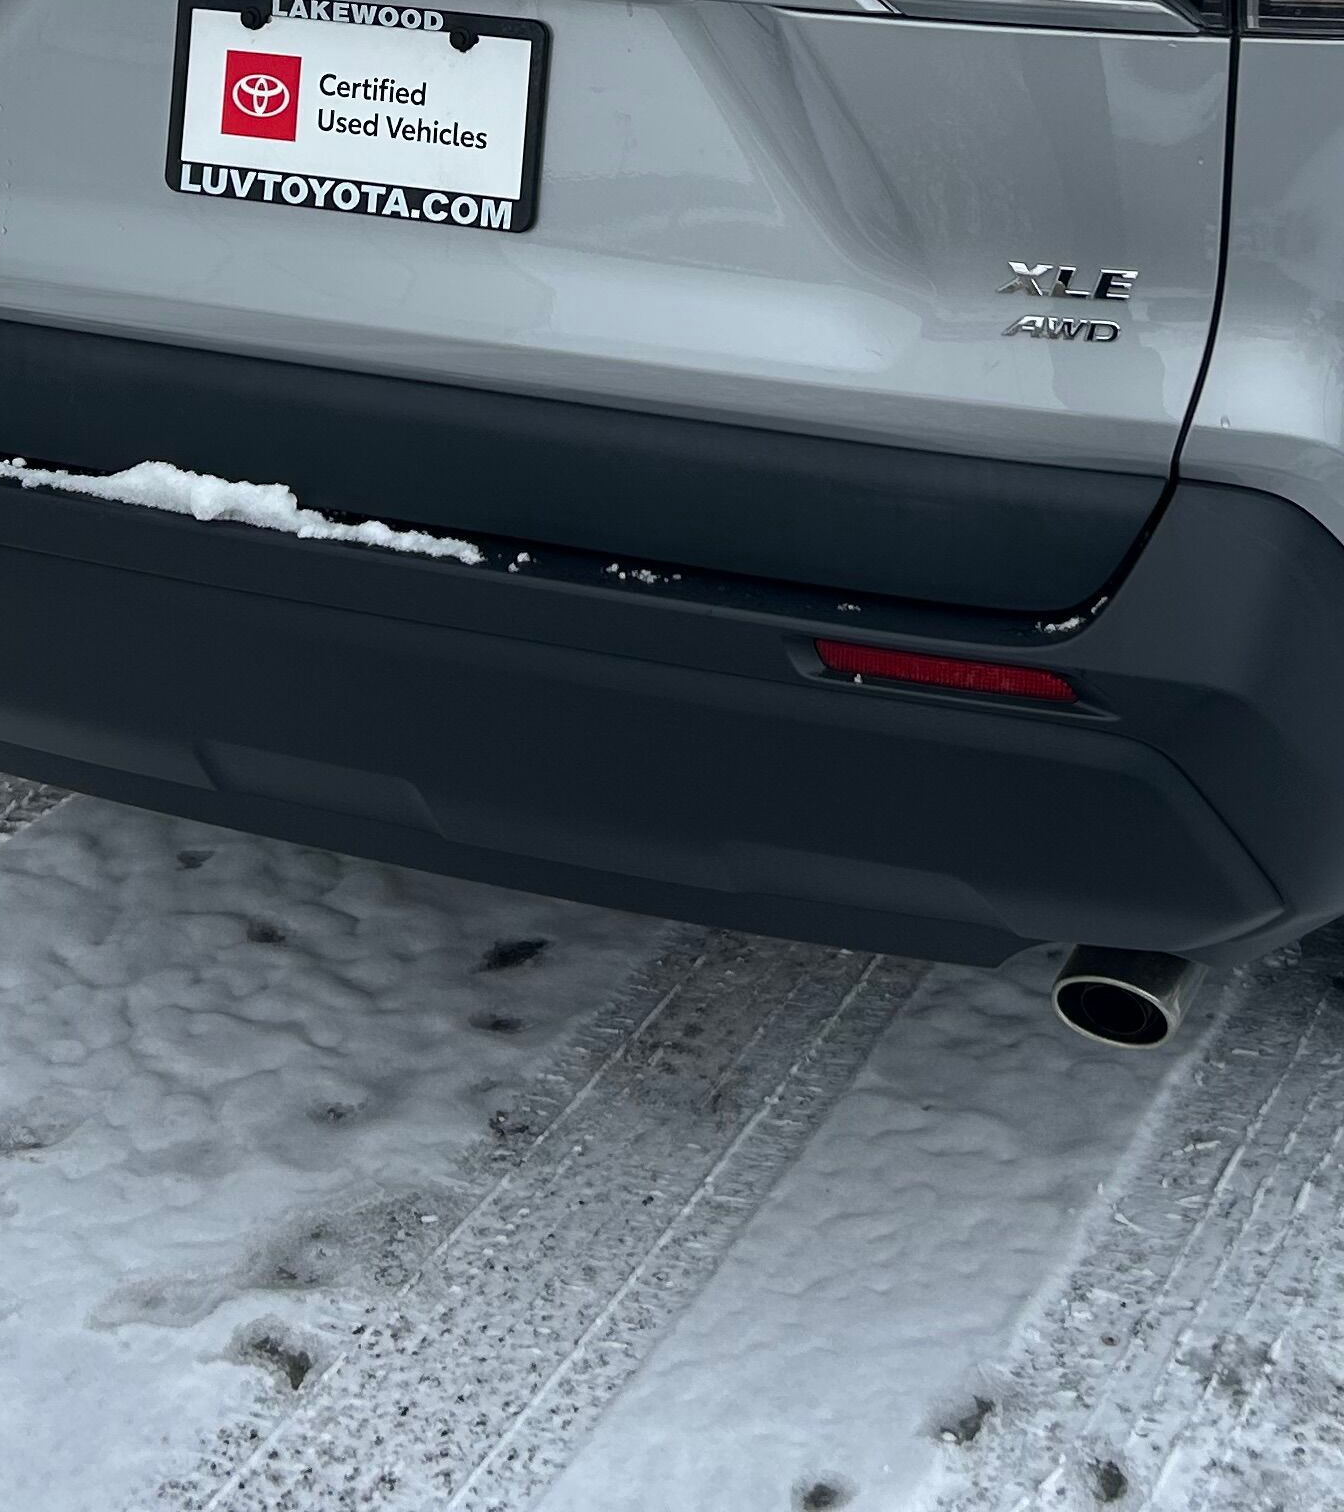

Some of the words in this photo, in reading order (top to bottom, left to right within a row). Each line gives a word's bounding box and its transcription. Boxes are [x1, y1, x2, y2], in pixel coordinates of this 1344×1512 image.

[319, 73, 427, 107] Certified
[317, 109, 380, 138] Used
[386, 115, 489, 151] Vehicles
[180, 163, 513, 231] LUVTOYOTA.COM
[995, 260, 1139, 300] XLE
[1001, 314, 1122, 343] AWD
